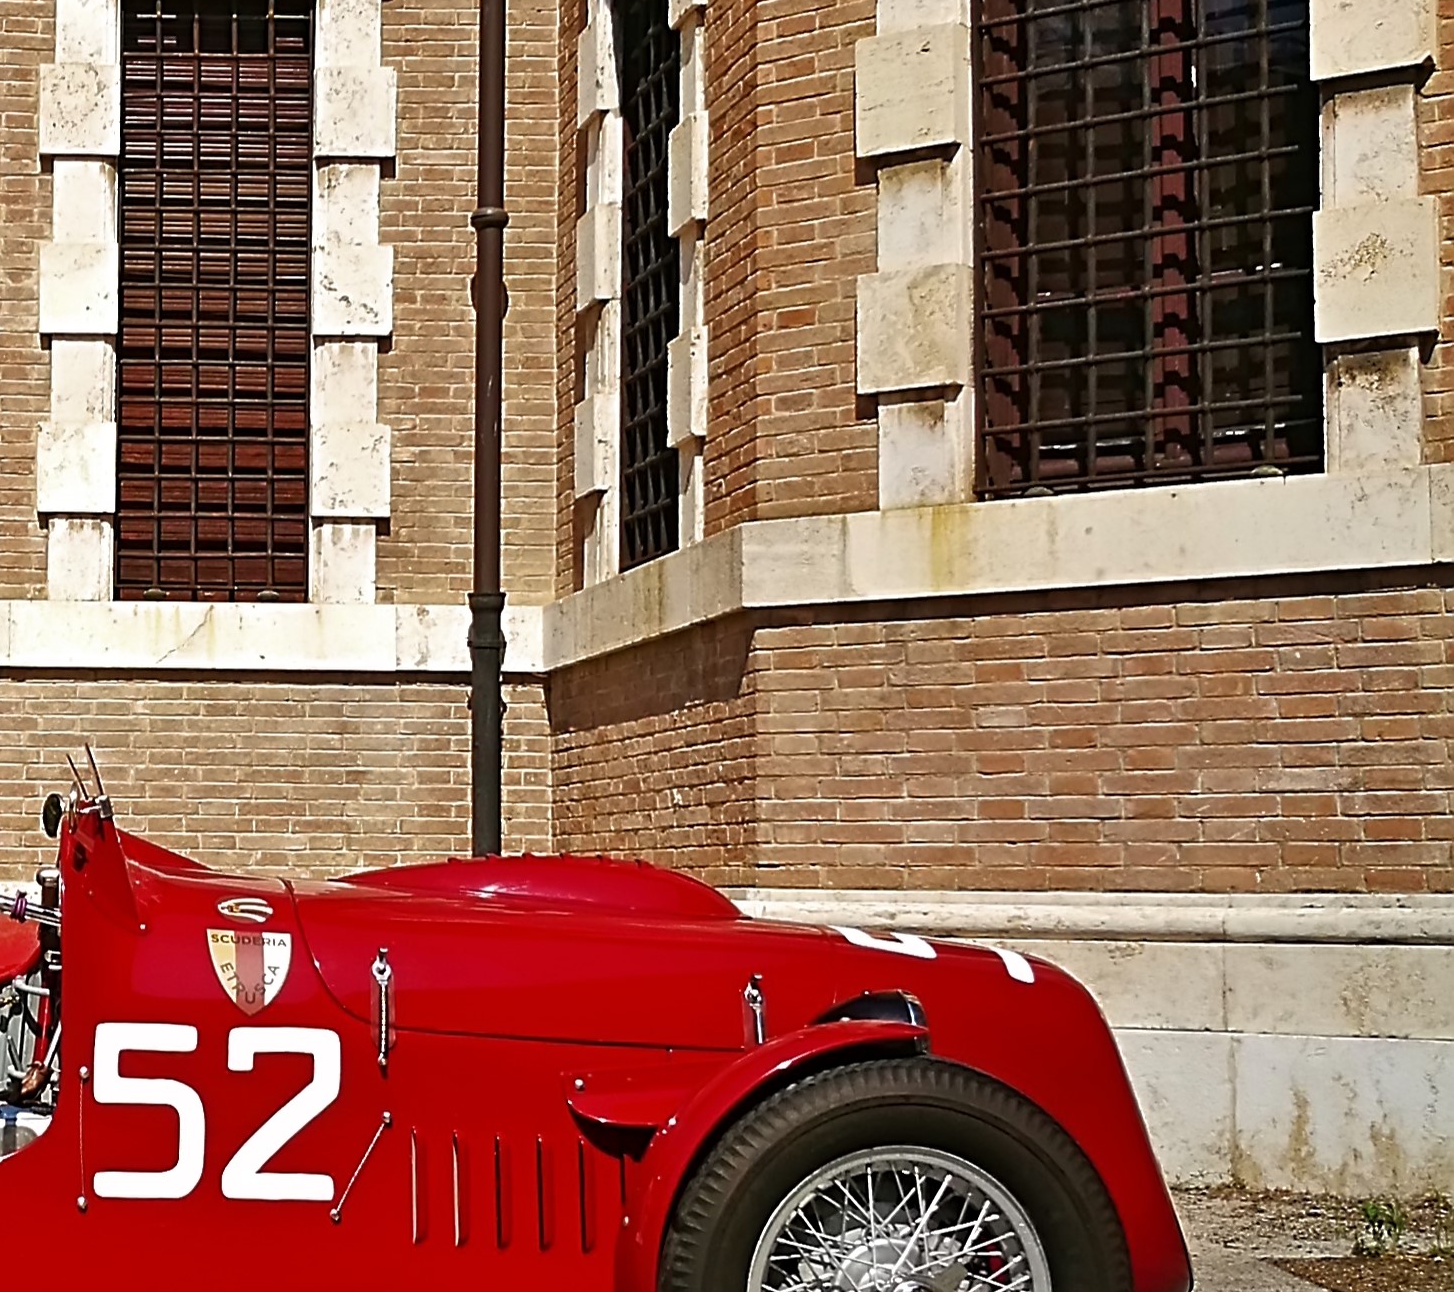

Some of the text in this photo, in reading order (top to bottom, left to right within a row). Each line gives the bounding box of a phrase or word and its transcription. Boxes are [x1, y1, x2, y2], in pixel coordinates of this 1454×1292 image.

[210, 933, 287, 947] SCUDERIA
[220, 962, 280, 1004] ETRUSCA
[93, 1022, 341, 1201] 52
